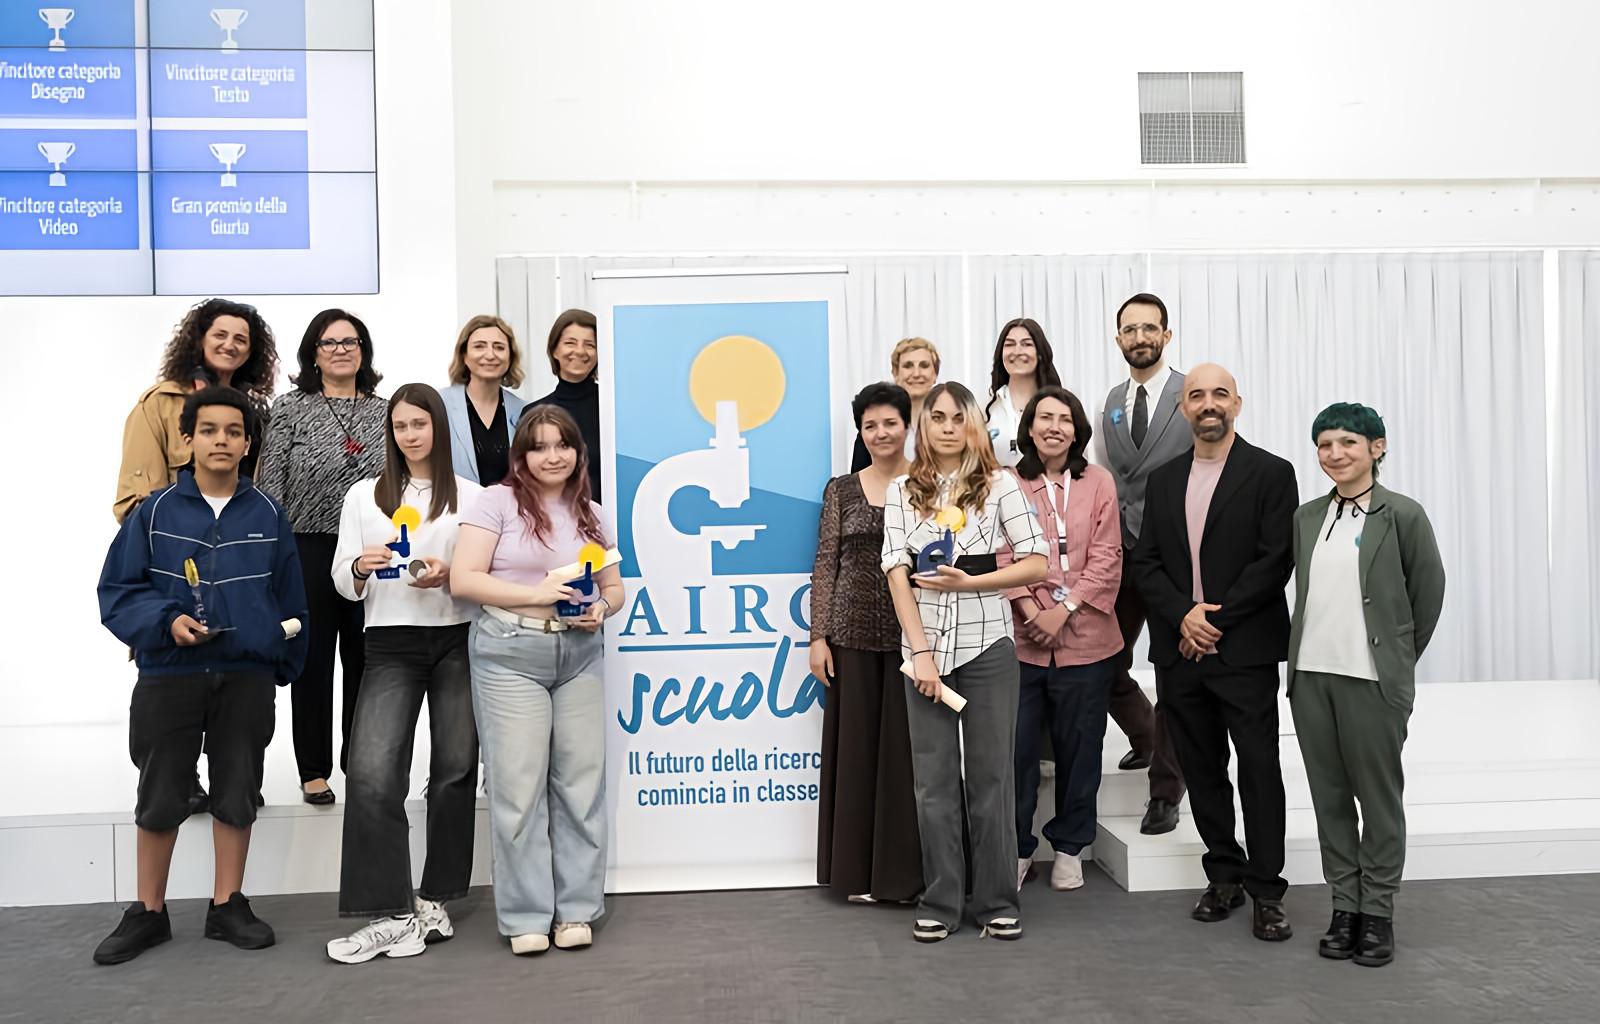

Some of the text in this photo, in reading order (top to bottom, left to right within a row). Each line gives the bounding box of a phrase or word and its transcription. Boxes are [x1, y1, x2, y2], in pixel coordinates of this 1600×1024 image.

[58, 62, 121, 82] categoria
[165, 64, 295, 85] Vincitore categoria
[31, 83, 85, 103] Disegno
[212, 86, 249, 102] Testo
[0, 197, 122, 217] incitore categoria
[171, 196, 287, 216] Gran premio della
[39, 218, 78, 234] Video
[211, 219, 249, 234] Giuria
[617, 635, 825, 734] scuola
[628, 747, 821, 775] Il futuro della ricerc
[638, 778, 818, 806] comincia in classe
